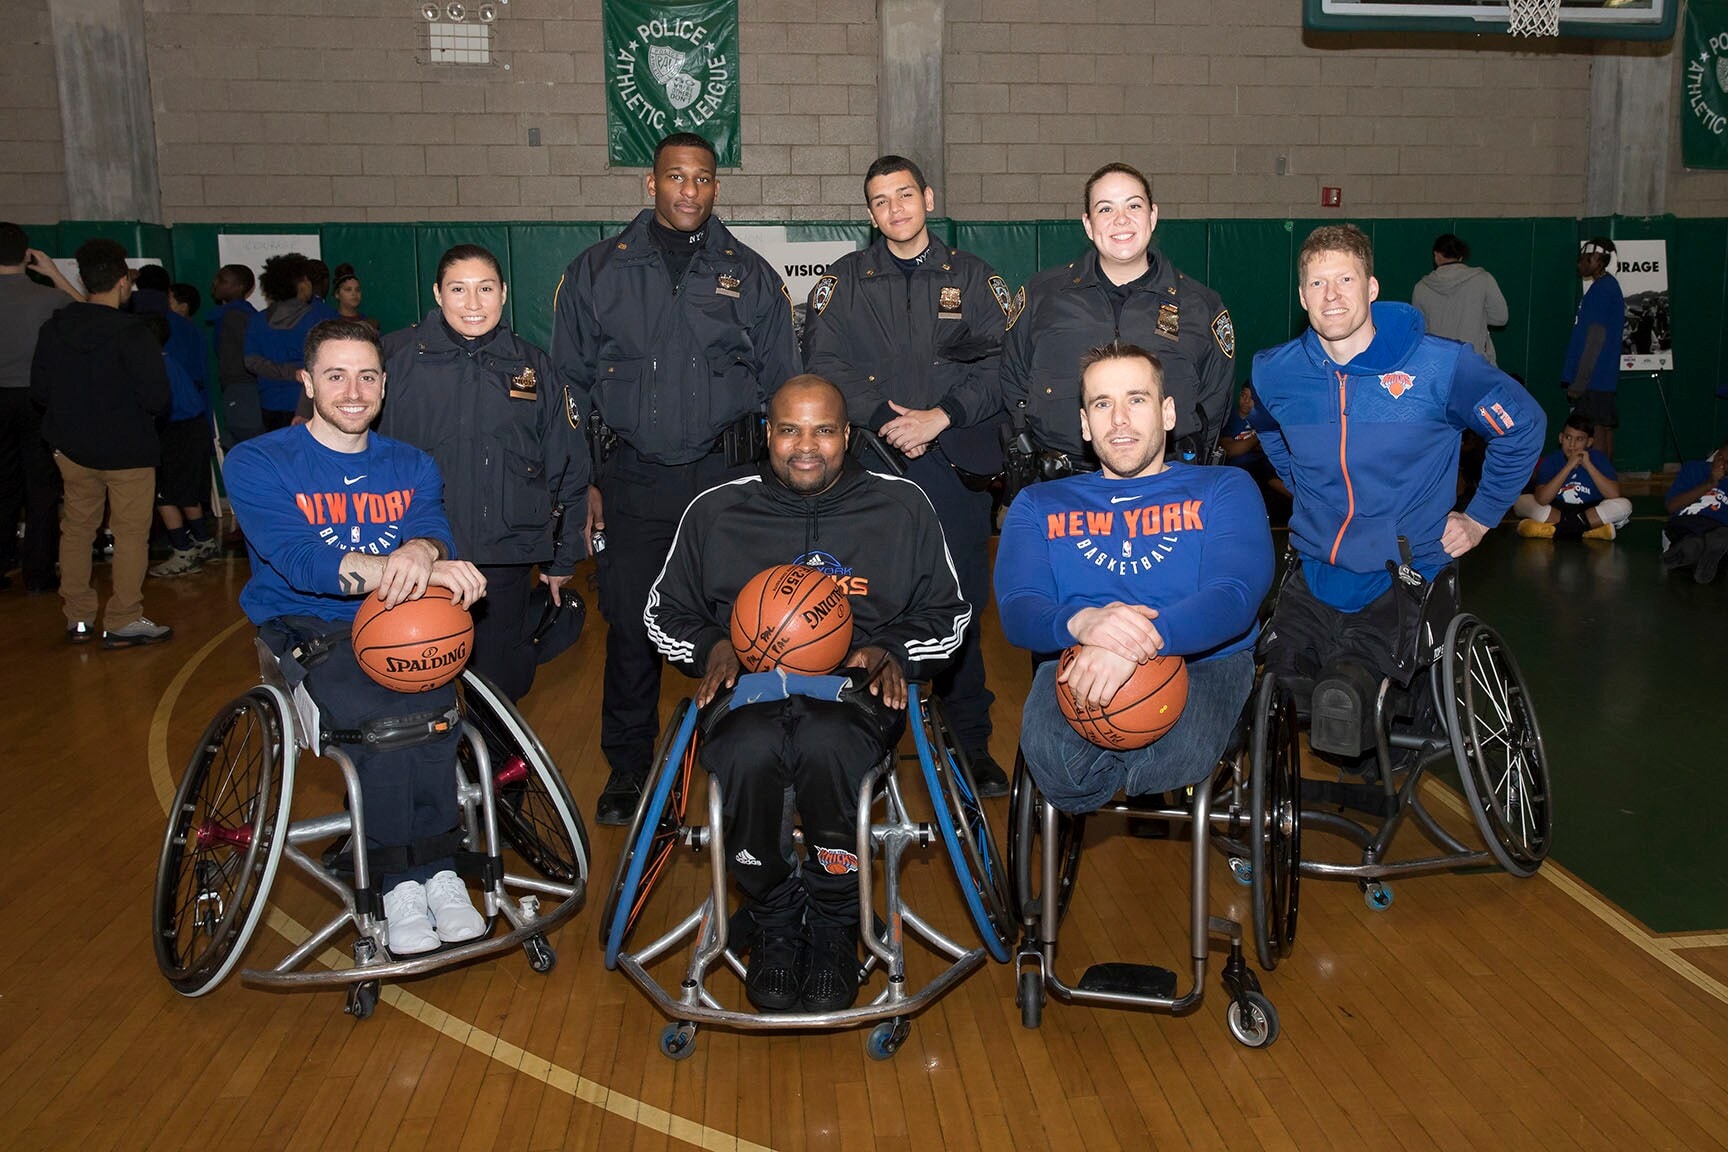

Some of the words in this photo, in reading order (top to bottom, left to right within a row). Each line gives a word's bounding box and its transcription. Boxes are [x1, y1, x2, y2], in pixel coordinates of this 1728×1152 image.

[637, 18, 707, 46] POLICE
[616, 47, 666, 129] ATHLETIC
[688, 54, 728, 126] LEAGUE
[1687, 60, 1727, 134] ATHLETIC
[784, 264, 830, 277] VISIO
[1047, 510, 1114, 540] NEW
[1123, 499, 1204, 539] YORK
[1076, 535, 1178, 576] BASKETBALL
[386, 641, 466, 672] SPALDING
[772, 637, 790, 654] PAL
